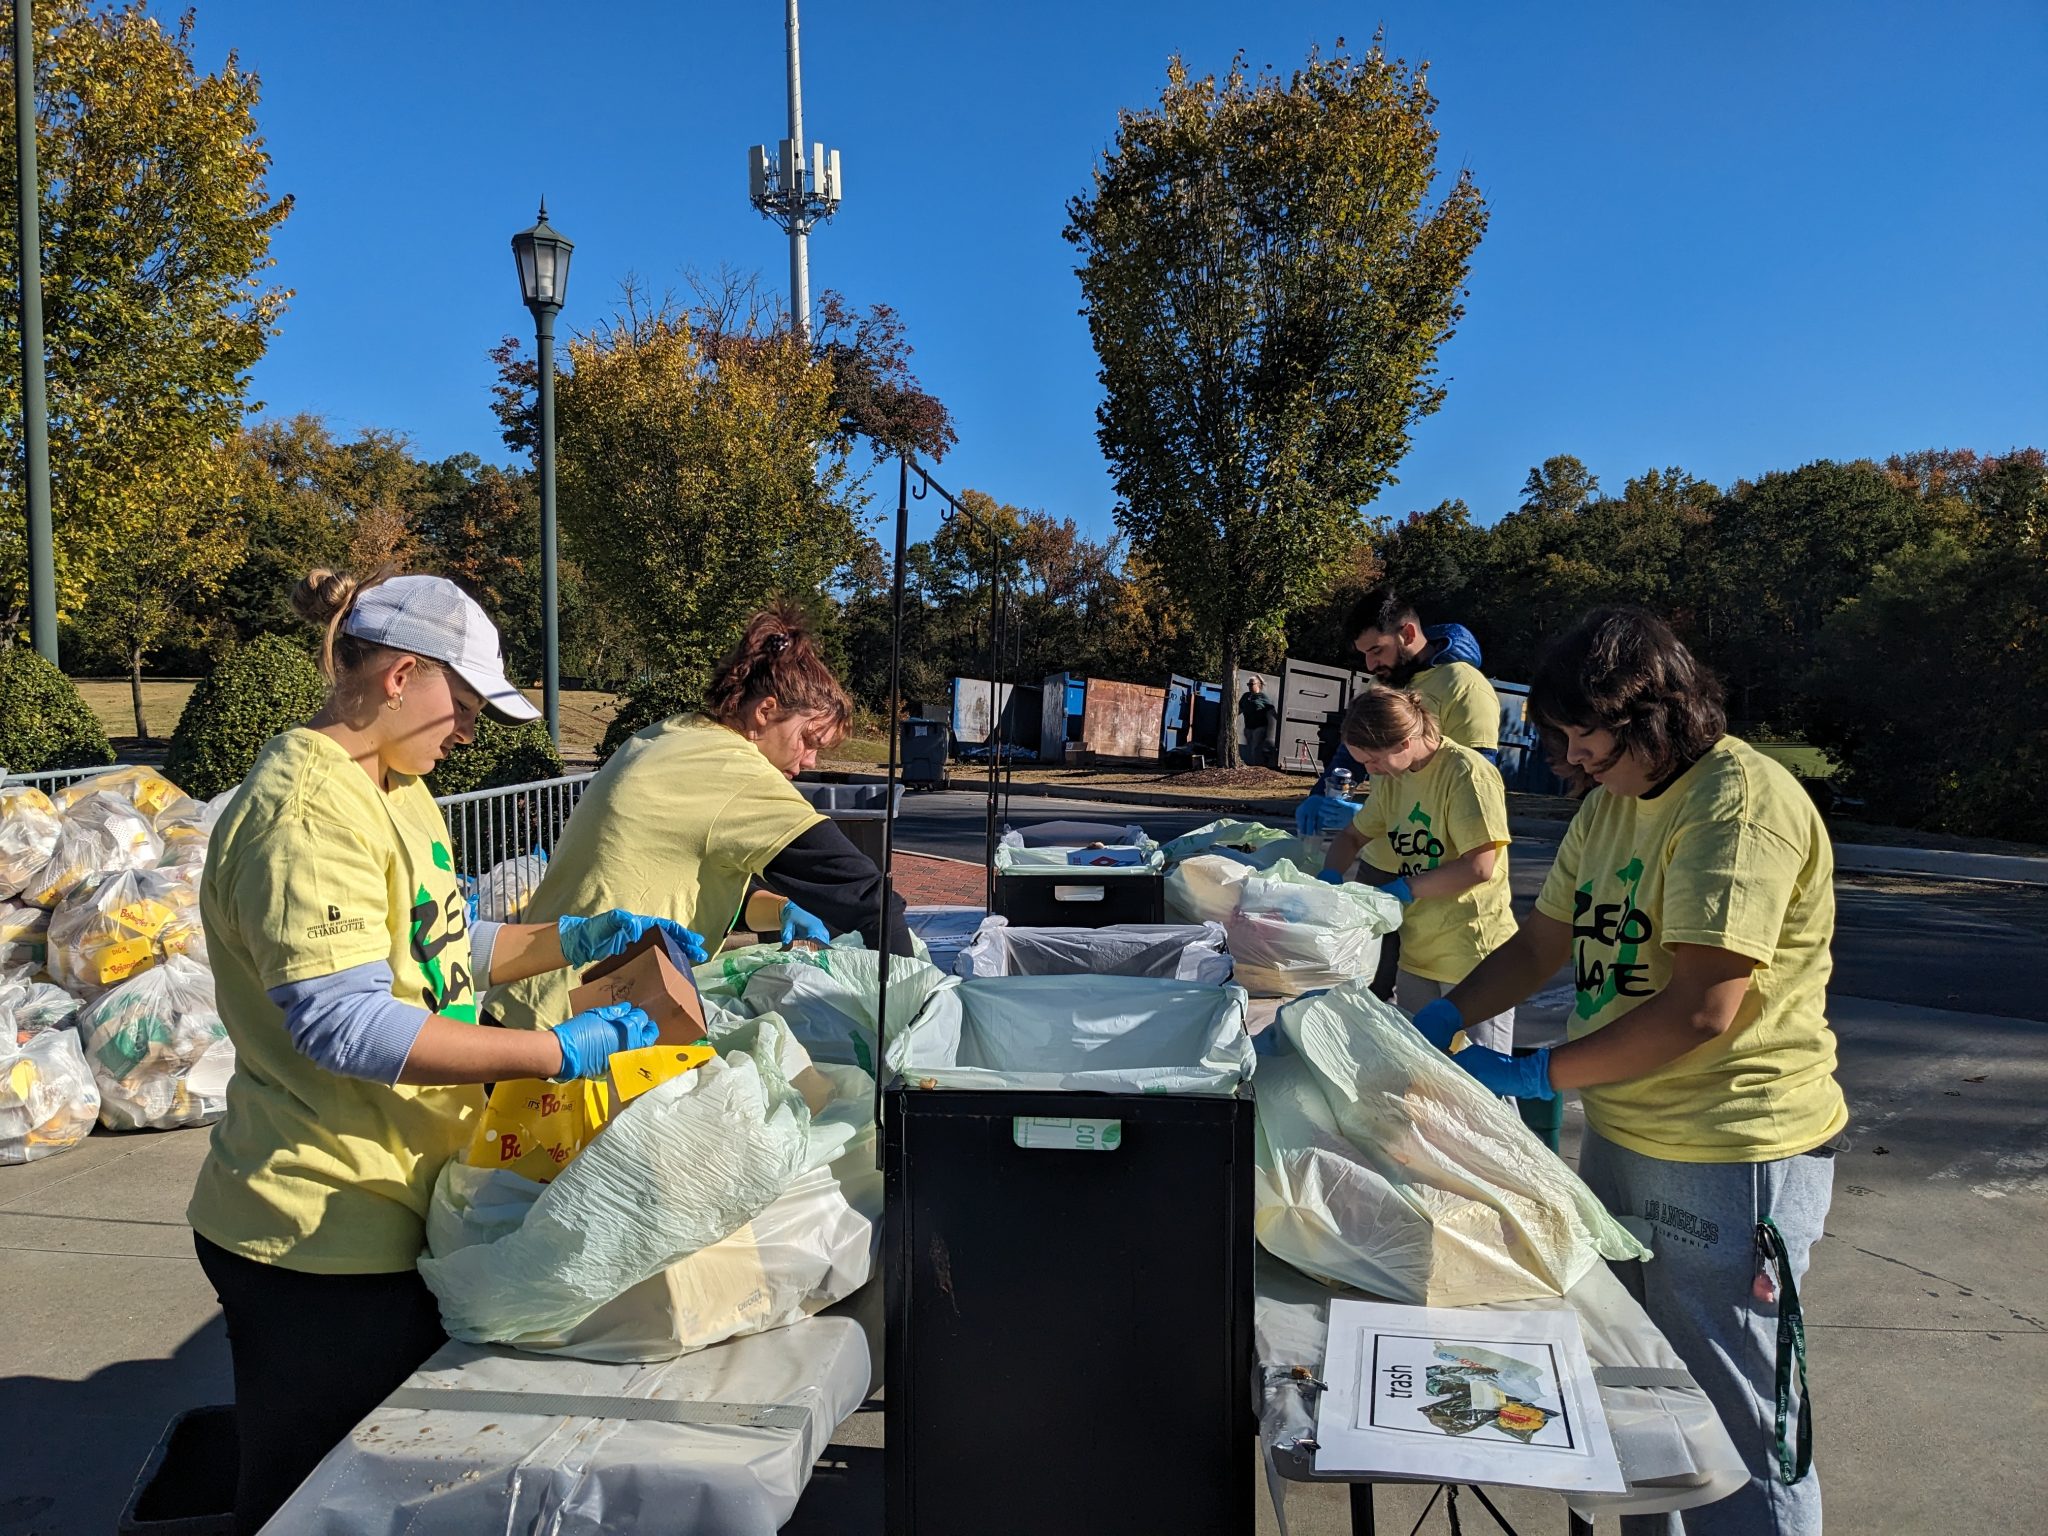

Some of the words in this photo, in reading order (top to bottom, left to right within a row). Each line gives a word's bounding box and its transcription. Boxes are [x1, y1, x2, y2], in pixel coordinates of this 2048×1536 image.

[307, 921, 365, 939] CHARLOTTE
[1660, 1203, 1719, 1245] ANGELES
[1382, 1365, 1412, 1398] trash
